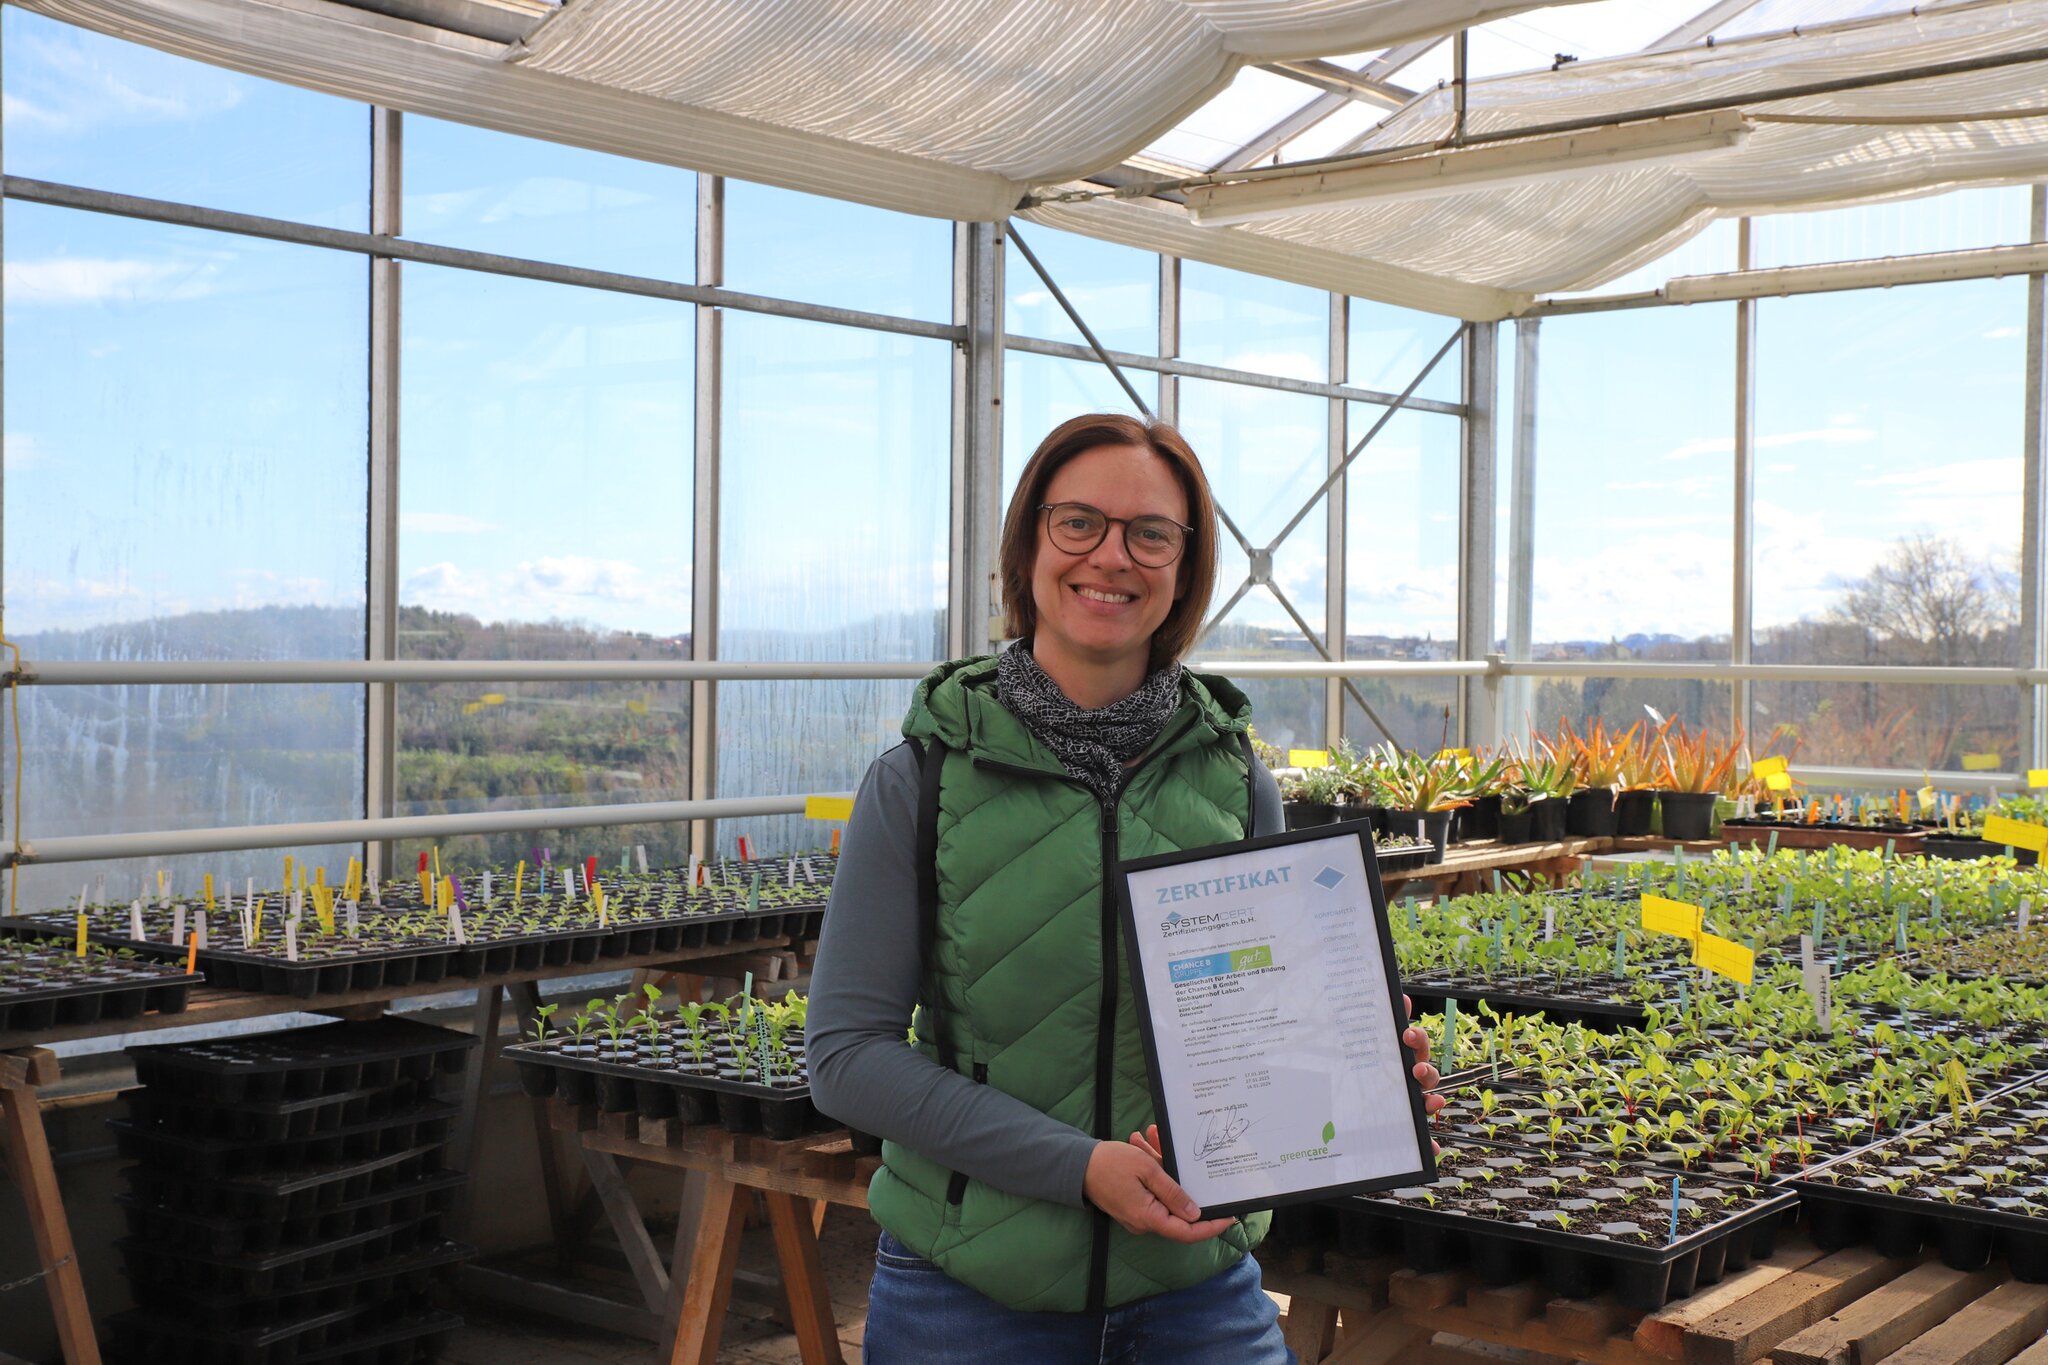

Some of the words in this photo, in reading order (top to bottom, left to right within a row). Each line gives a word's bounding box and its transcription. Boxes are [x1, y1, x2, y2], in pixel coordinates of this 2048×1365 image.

[1155, 866, 1293, 904] ZERTIFIKAT
[1160, 906, 1255, 930] SYSTEMCERT
[1162, 916, 1256, 939] Zertifizierungsges.m.b.H.
[1172, 960, 1204, 971] CHANCE
[1173, 967, 1203, 978] GRUPPE
[1173, 976, 1214, 988] Gesellschaft
[1225, 971, 1246, 979] Arbeit
[1260, 964, 1286, 974] Bildung
[1176, 990, 1220, 1002] Biobauernhof
[1220, 986, 1244, 995] Labuch
[1187, 984, 1211, 993] Chance
[1218, 979, 1238, 988] GmbH
[1279, 1146, 1329, 1164] greencare
